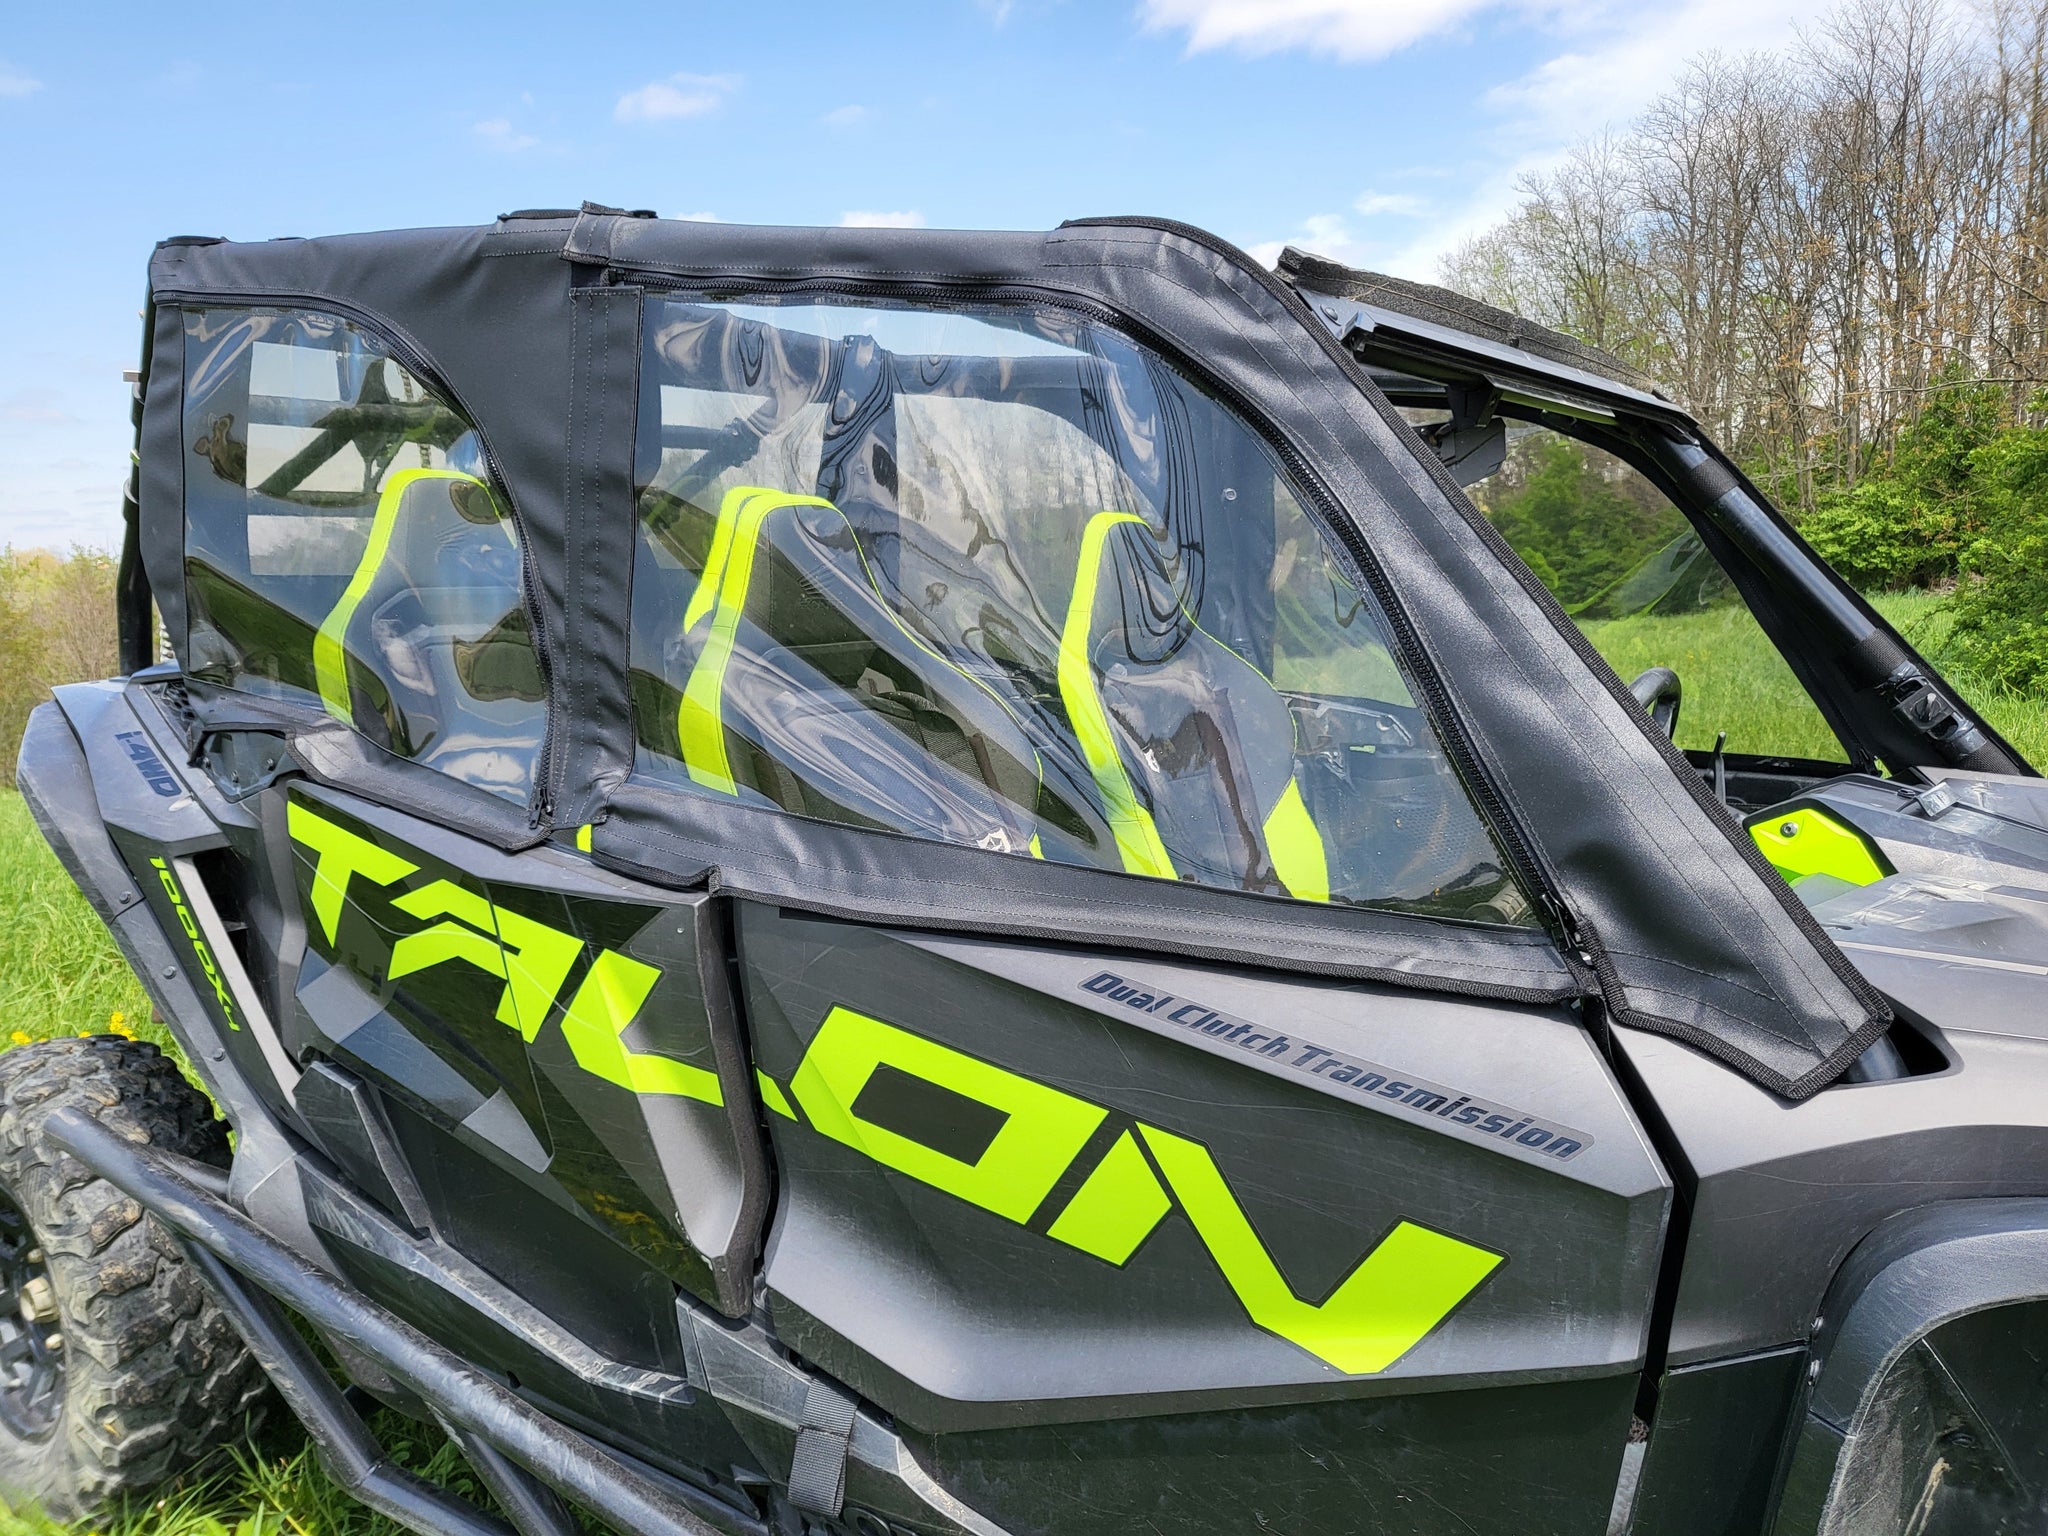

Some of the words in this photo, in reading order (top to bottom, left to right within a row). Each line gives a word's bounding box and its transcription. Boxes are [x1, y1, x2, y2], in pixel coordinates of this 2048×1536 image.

[115, 731, 182, 797] i-4WD
[287, 800, 1504, 1374] TALON
[1081, 973, 1168, 1013] Dual
[1166, 1004, 1291, 1057] Clutch
[1290, 1044, 1583, 1158] Transmission
